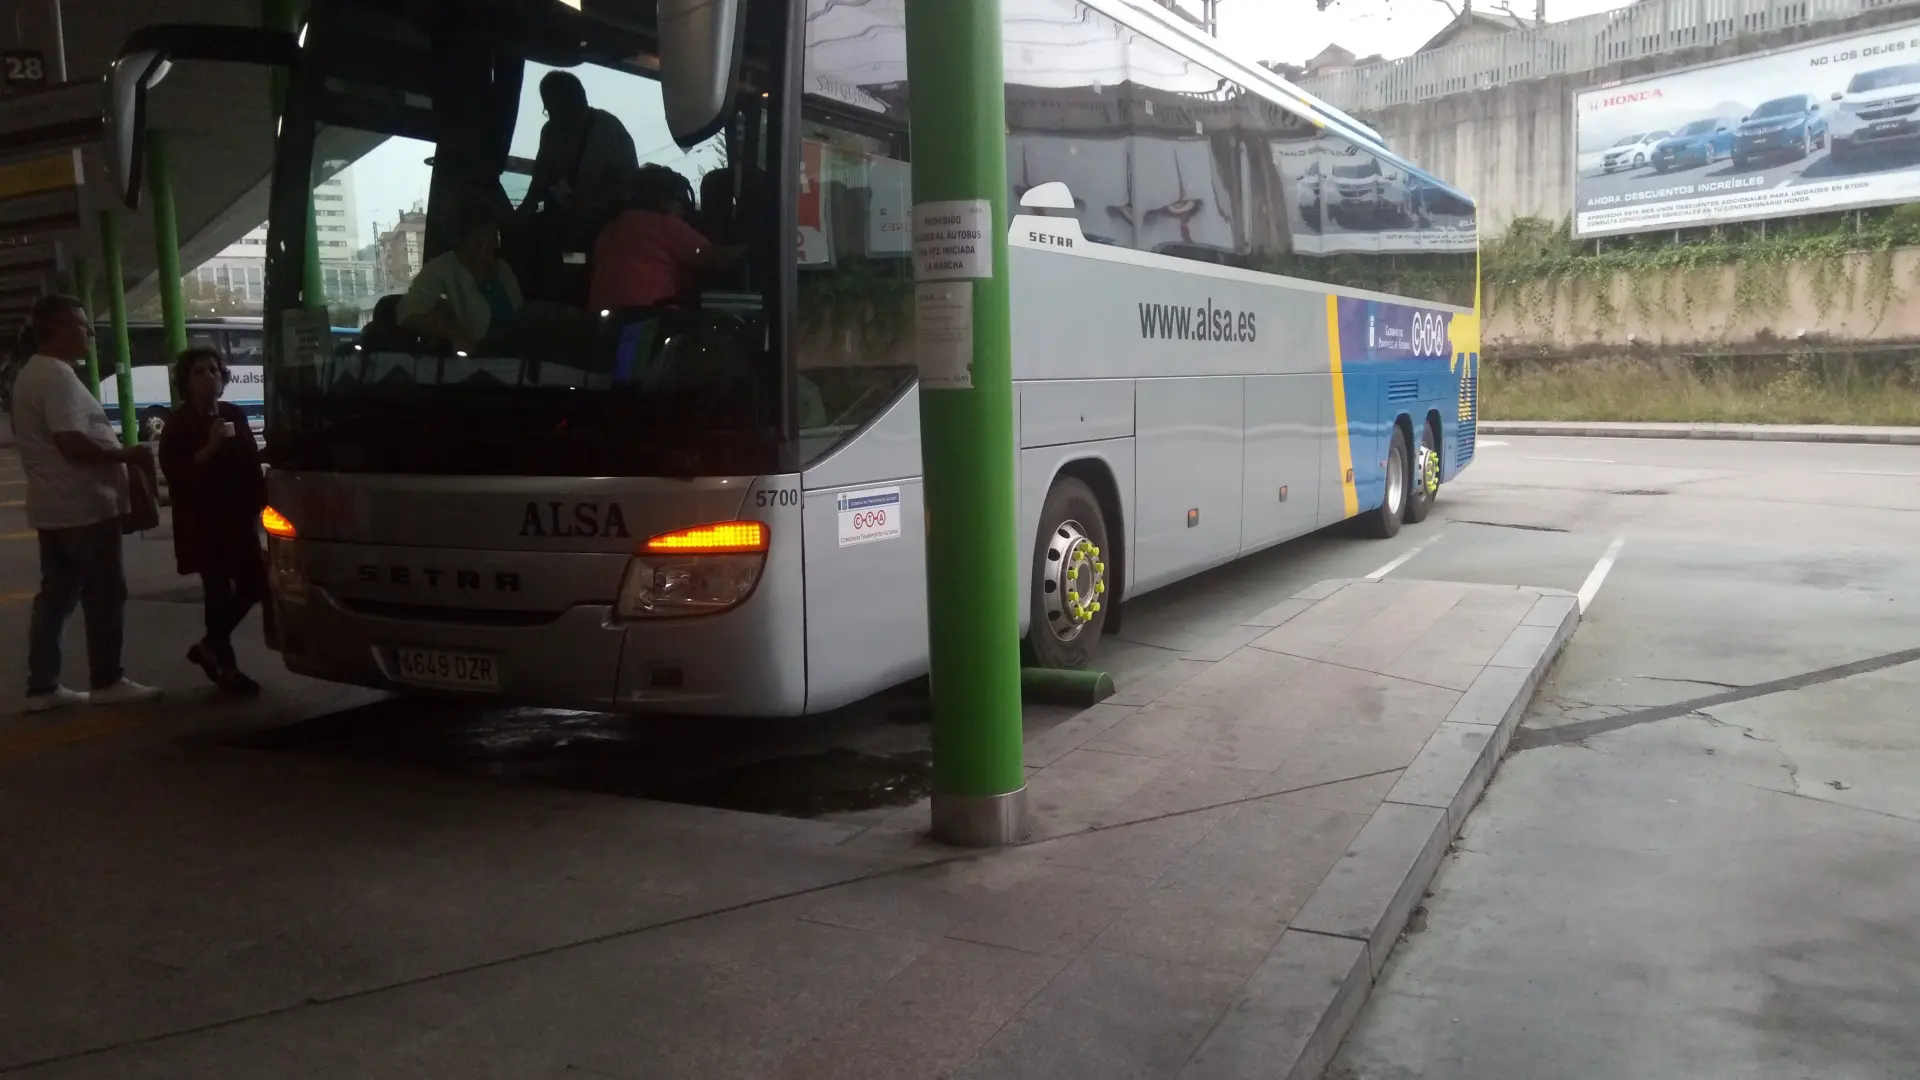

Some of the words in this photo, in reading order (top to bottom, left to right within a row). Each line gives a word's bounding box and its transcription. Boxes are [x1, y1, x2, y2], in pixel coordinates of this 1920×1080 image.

[1810, 56, 1828, 67] NO
[1833, 50, 1858, 62] LOS
[1862, 41, 1905, 57] DEJES
[1910, 39, 1920, 48] E
[6, 57, 43, 80] 28
[1604, 88, 1664, 107] HONDA
[1588, 195, 1622, 206] AHORA
[1624, 185, 1694, 201] DESCUENTOS
[1698, 176, 1764, 192] INCREÍBLES
[1721, 194, 1768, 205] ADICIONALES
[1791, 187, 1829, 196] UNIDADES
[1784, 196, 1810, 204] HONDA
[947, 230, 982, 239] AUTOBUS
[1029, 231, 1073, 248] SETRA
[1139, 297, 1256, 342] www.alsa.es
[756, 489, 798, 508] 5700
[519, 501, 631, 538] ALSA
[357, 565, 520, 590] SETRA
[404, 652, 449, 677] 4649
[455, 657, 492, 681] DZR
